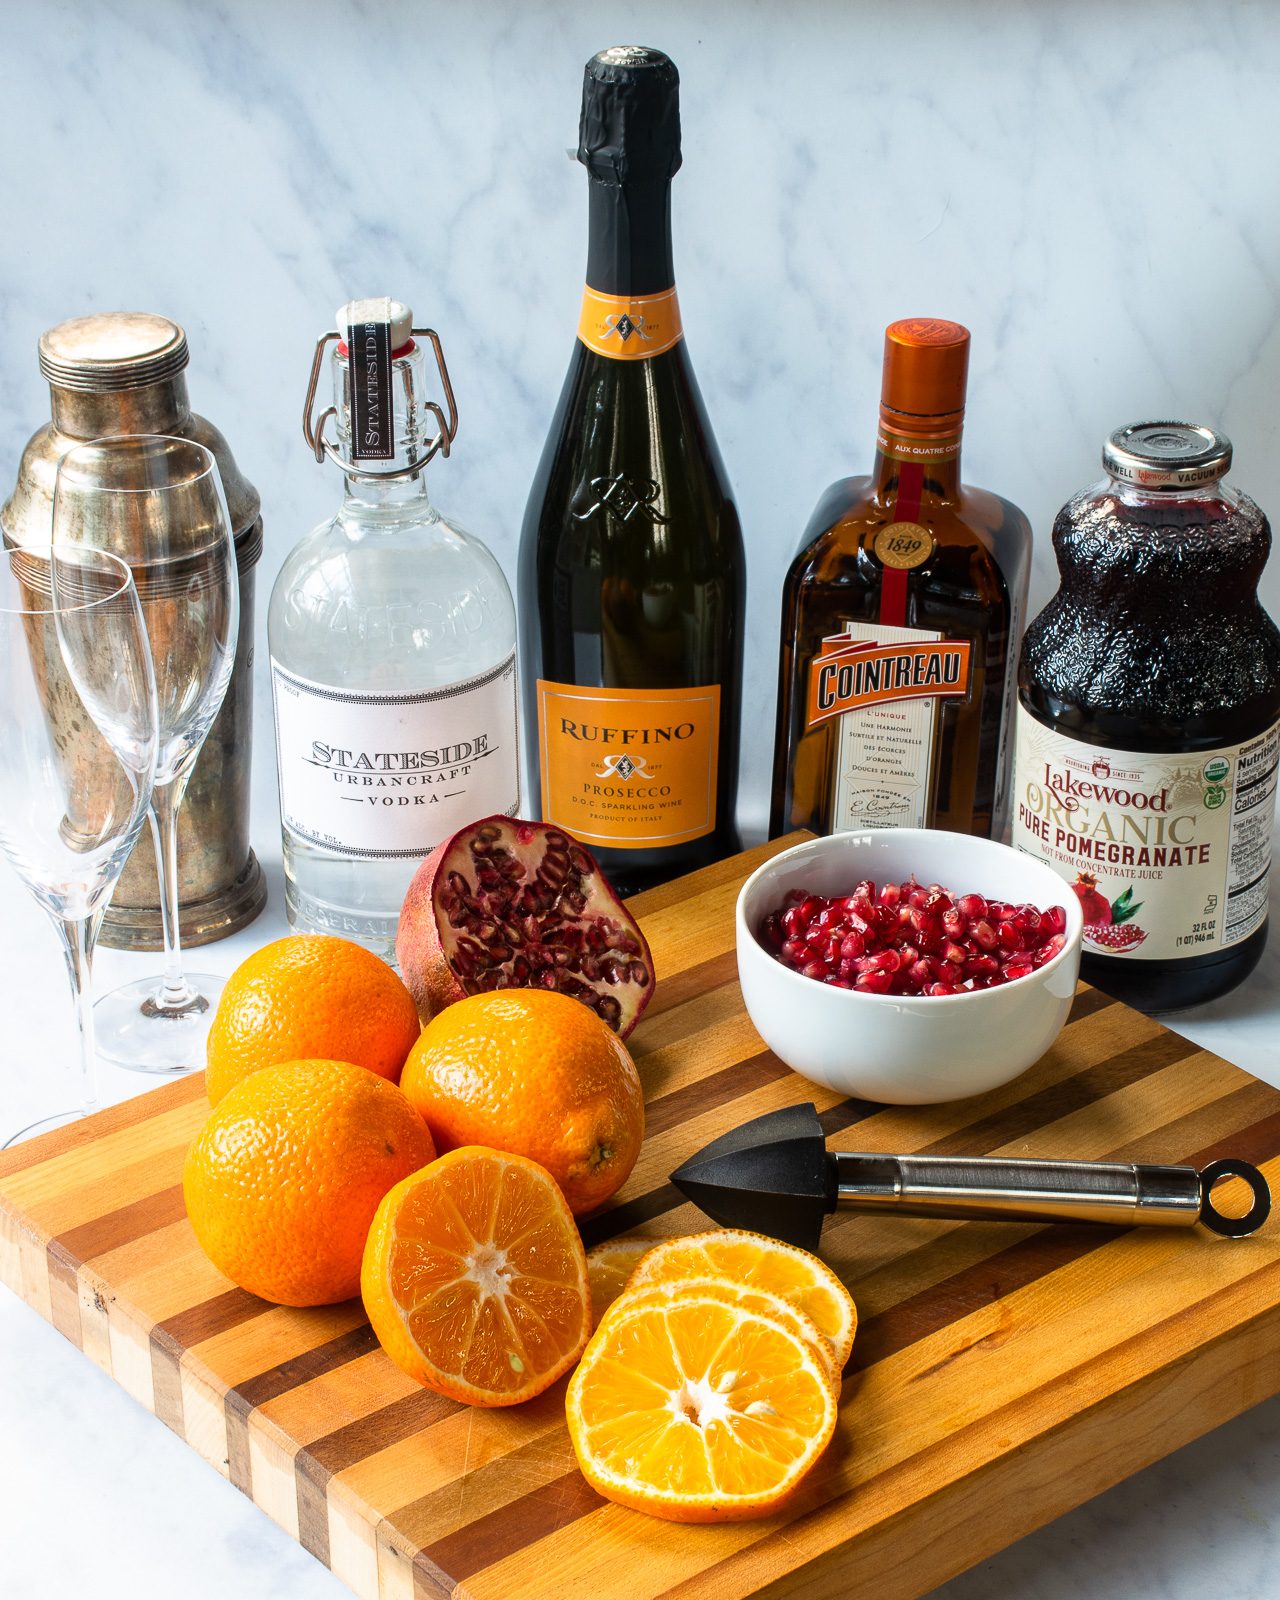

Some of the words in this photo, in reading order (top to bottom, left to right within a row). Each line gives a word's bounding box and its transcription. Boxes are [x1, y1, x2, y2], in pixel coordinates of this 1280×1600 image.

[365, 323, 380, 446] STATESIDE
[895, 444, 911, 453] AUX
[912, 447, 944, 455] QUATRE
[1114, 464, 1133, 478] WELL
[1178, 468, 1215, 483] VACUUM
[887, 537, 922, 553] 1849
[817, 652, 962, 711] COINTREAU
[867, 710, 907, 720] L'UNIQUE
[560, 717, 695, 745] RUFFINO
[312, 733, 488, 771] STATESIDE
[1210, 761, 1225, 770] USDA
[333, 765, 472, 787] URBANCRAFT
[1112, 771, 1126, 779] SINCE
[583, 783, 671, 798] PROSECCO
[1043, 762, 1170, 813] Lakewood
[368, 793, 439, 806] VODKA
[601, 802, 655, 811] SPARKLING
[658, 798, 683, 809] WINE
[1235, 788, 1267, 811] Calories
[590, 813, 625, 822] PRODUCT
[1026, 781, 1197, 847] ORGANIC
[1018, 802, 1051, 843] PURE
[1055, 827, 1211, 868] POMEGRANATE
[1041, 843, 1054, 858] NOT
[1054, 850, 1075, 867] FROM
[1075, 858, 1137, 879] CONCENTRATE
[1137, 870, 1163, 880] JUICE
[1192, 923, 1201, 933] 32
[1201, 922, 1208, 931] FL
[1208, 920, 1216, 930] OZ
[1183, 935, 1194, 946] QT)
[1194, 933, 1206, 943] 946
